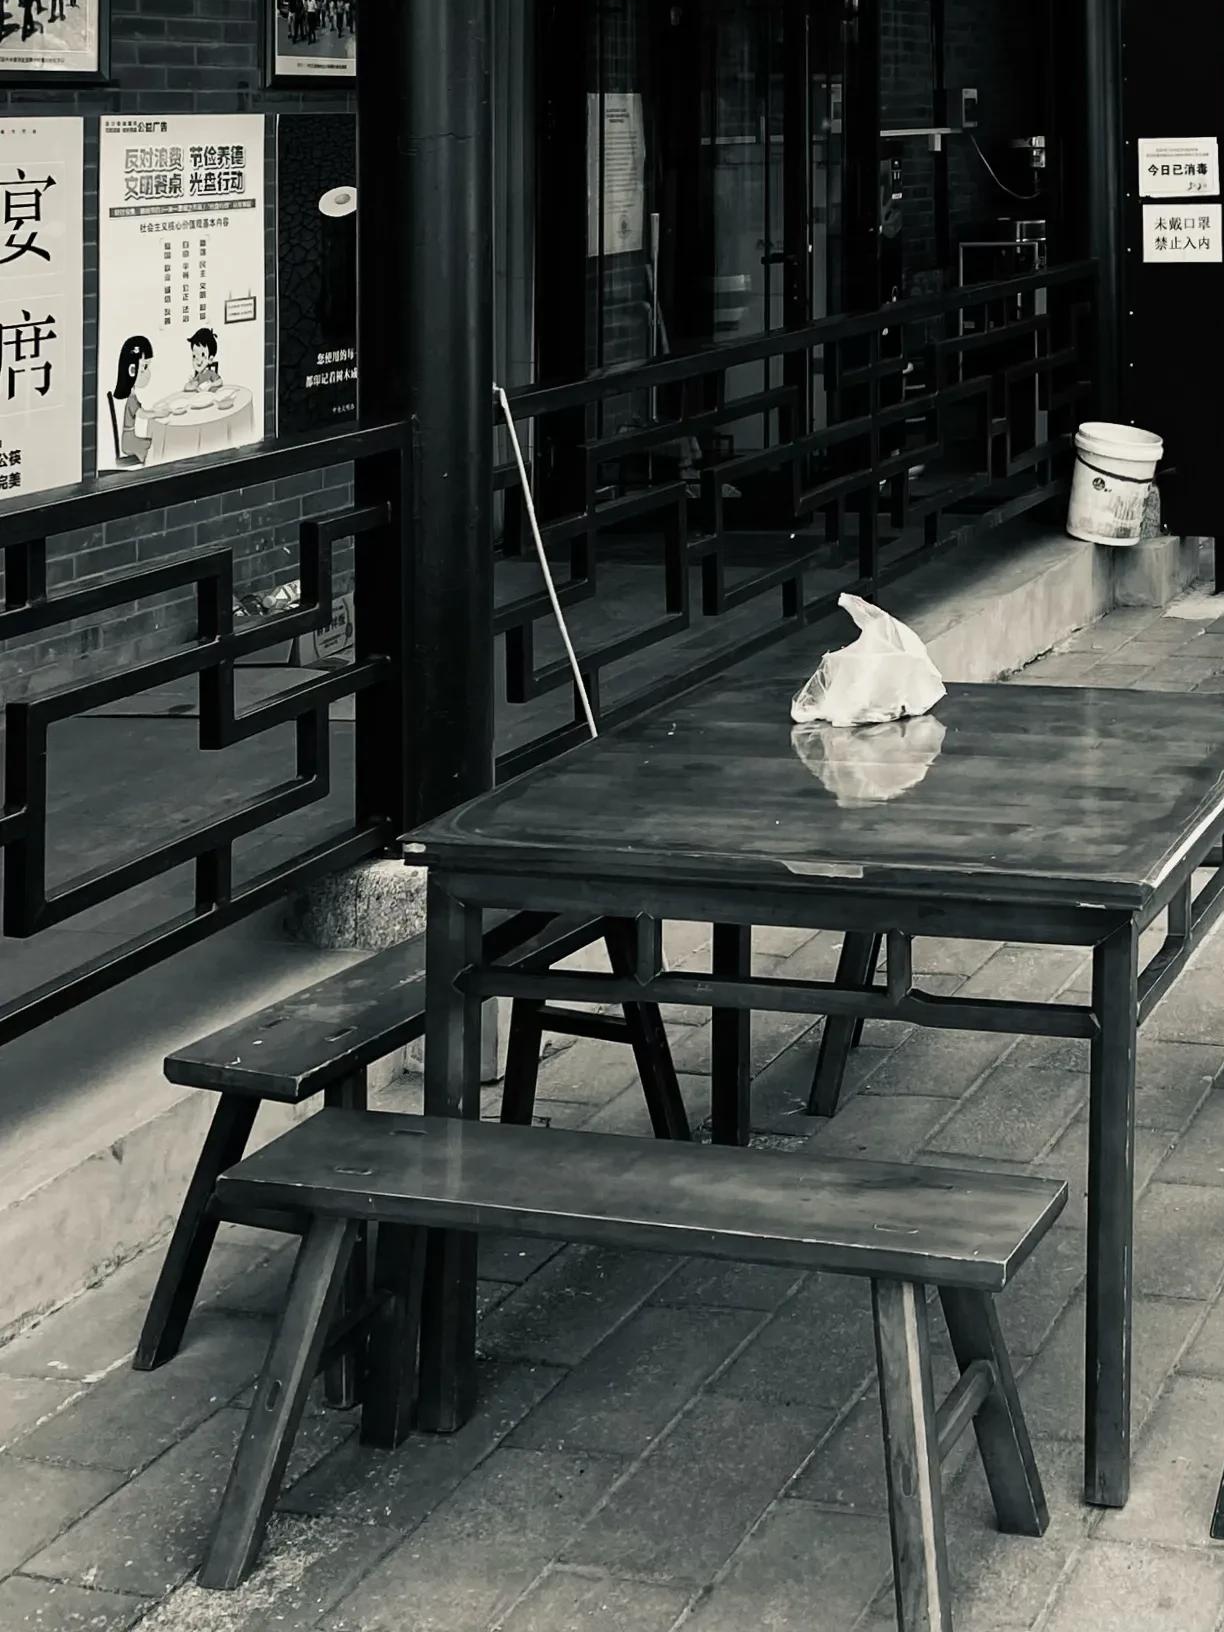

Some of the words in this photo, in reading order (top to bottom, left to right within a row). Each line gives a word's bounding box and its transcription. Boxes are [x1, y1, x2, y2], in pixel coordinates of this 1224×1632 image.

[125, 146, 182, 170] 反对浪费
[189, 145, 244, 167] 节俭养德
[1148, 162, 1208, 176] 今日已消毒
[125, 173, 182, 197] 文明餐桌
[189, 171, 244, 193] 光盘行动
[1155, 216, 1211, 231] 未戴口罩
[1155, 236, 1211, 251] 禁止入内
